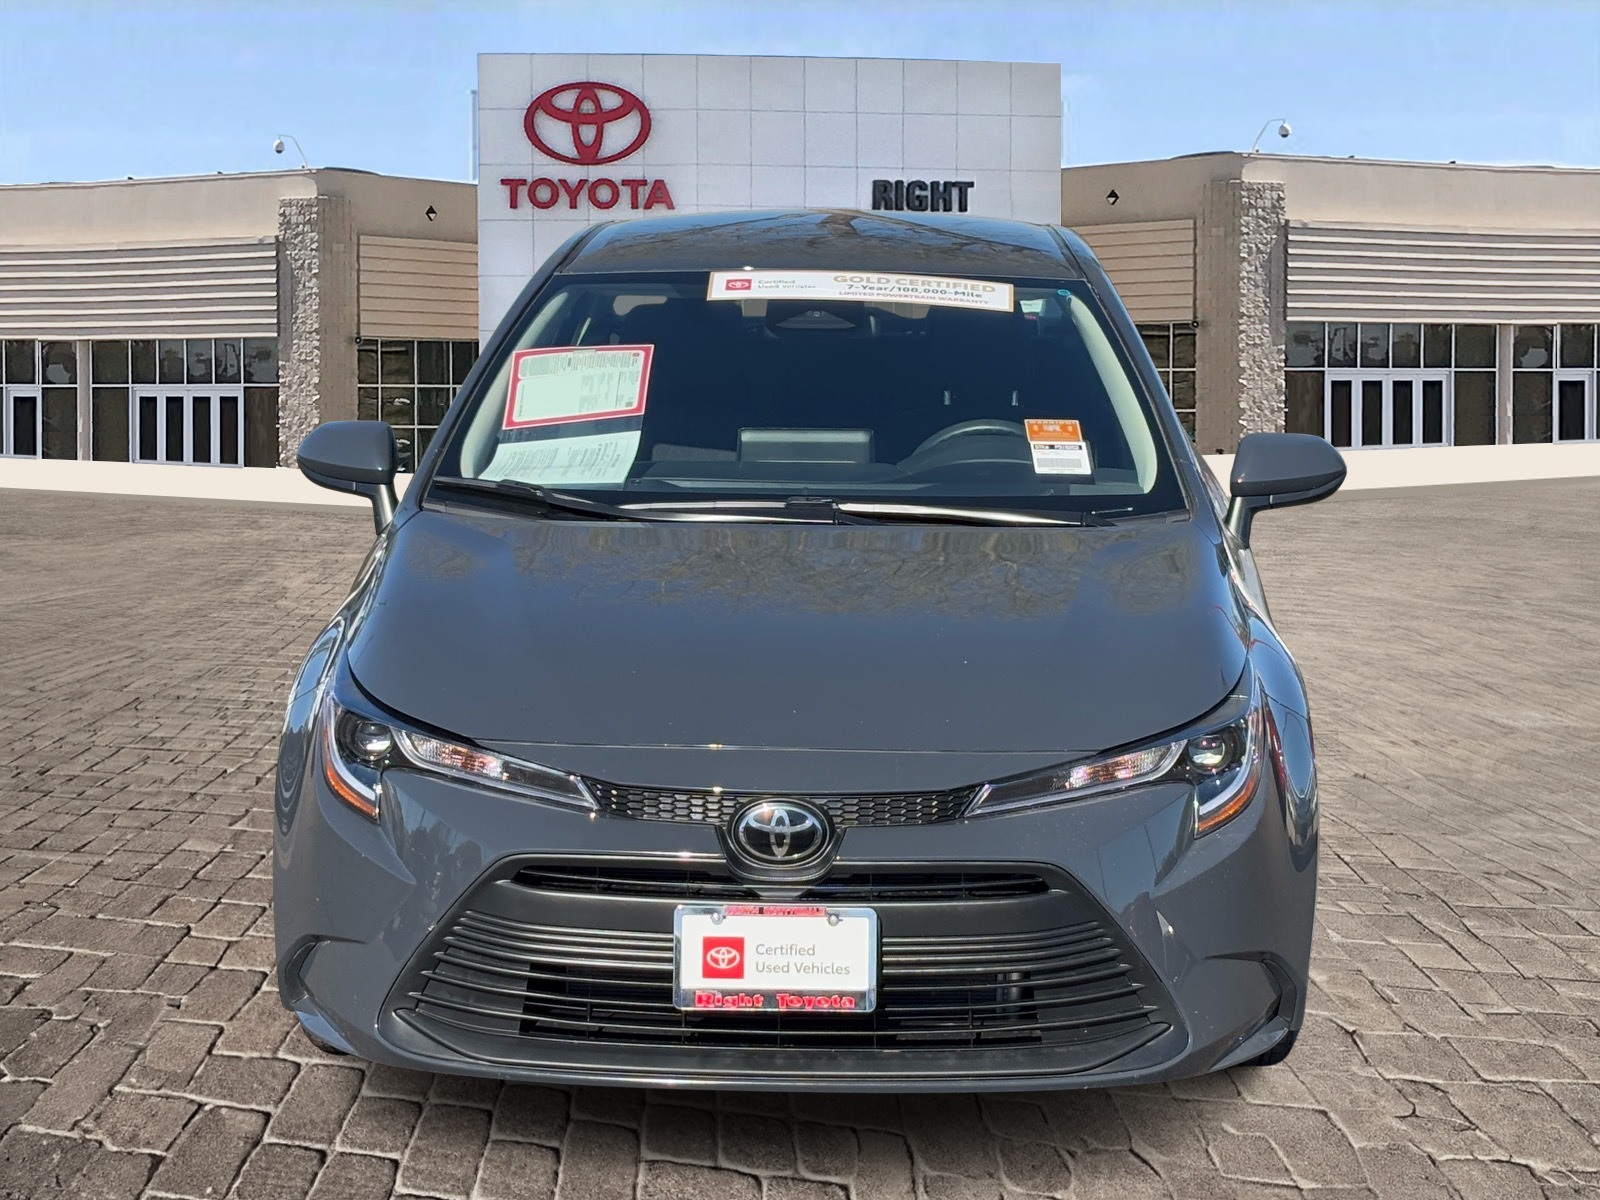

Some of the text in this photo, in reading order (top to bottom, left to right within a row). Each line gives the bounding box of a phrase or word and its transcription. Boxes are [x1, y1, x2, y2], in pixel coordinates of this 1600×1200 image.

[500, 178, 676, 210] TOYOTA
[871, 179, 975, 213] RIGHT
[833, 275, 996, 293] GOLD CERTIFIED
[846, 284, 983, 298] 7-Year/100,000-Mile
[755, 943, 816, 957] Certified
[755, 962, 851, 975] Used Vehicles
[695, 990, 855, 1009] Right Toyota
